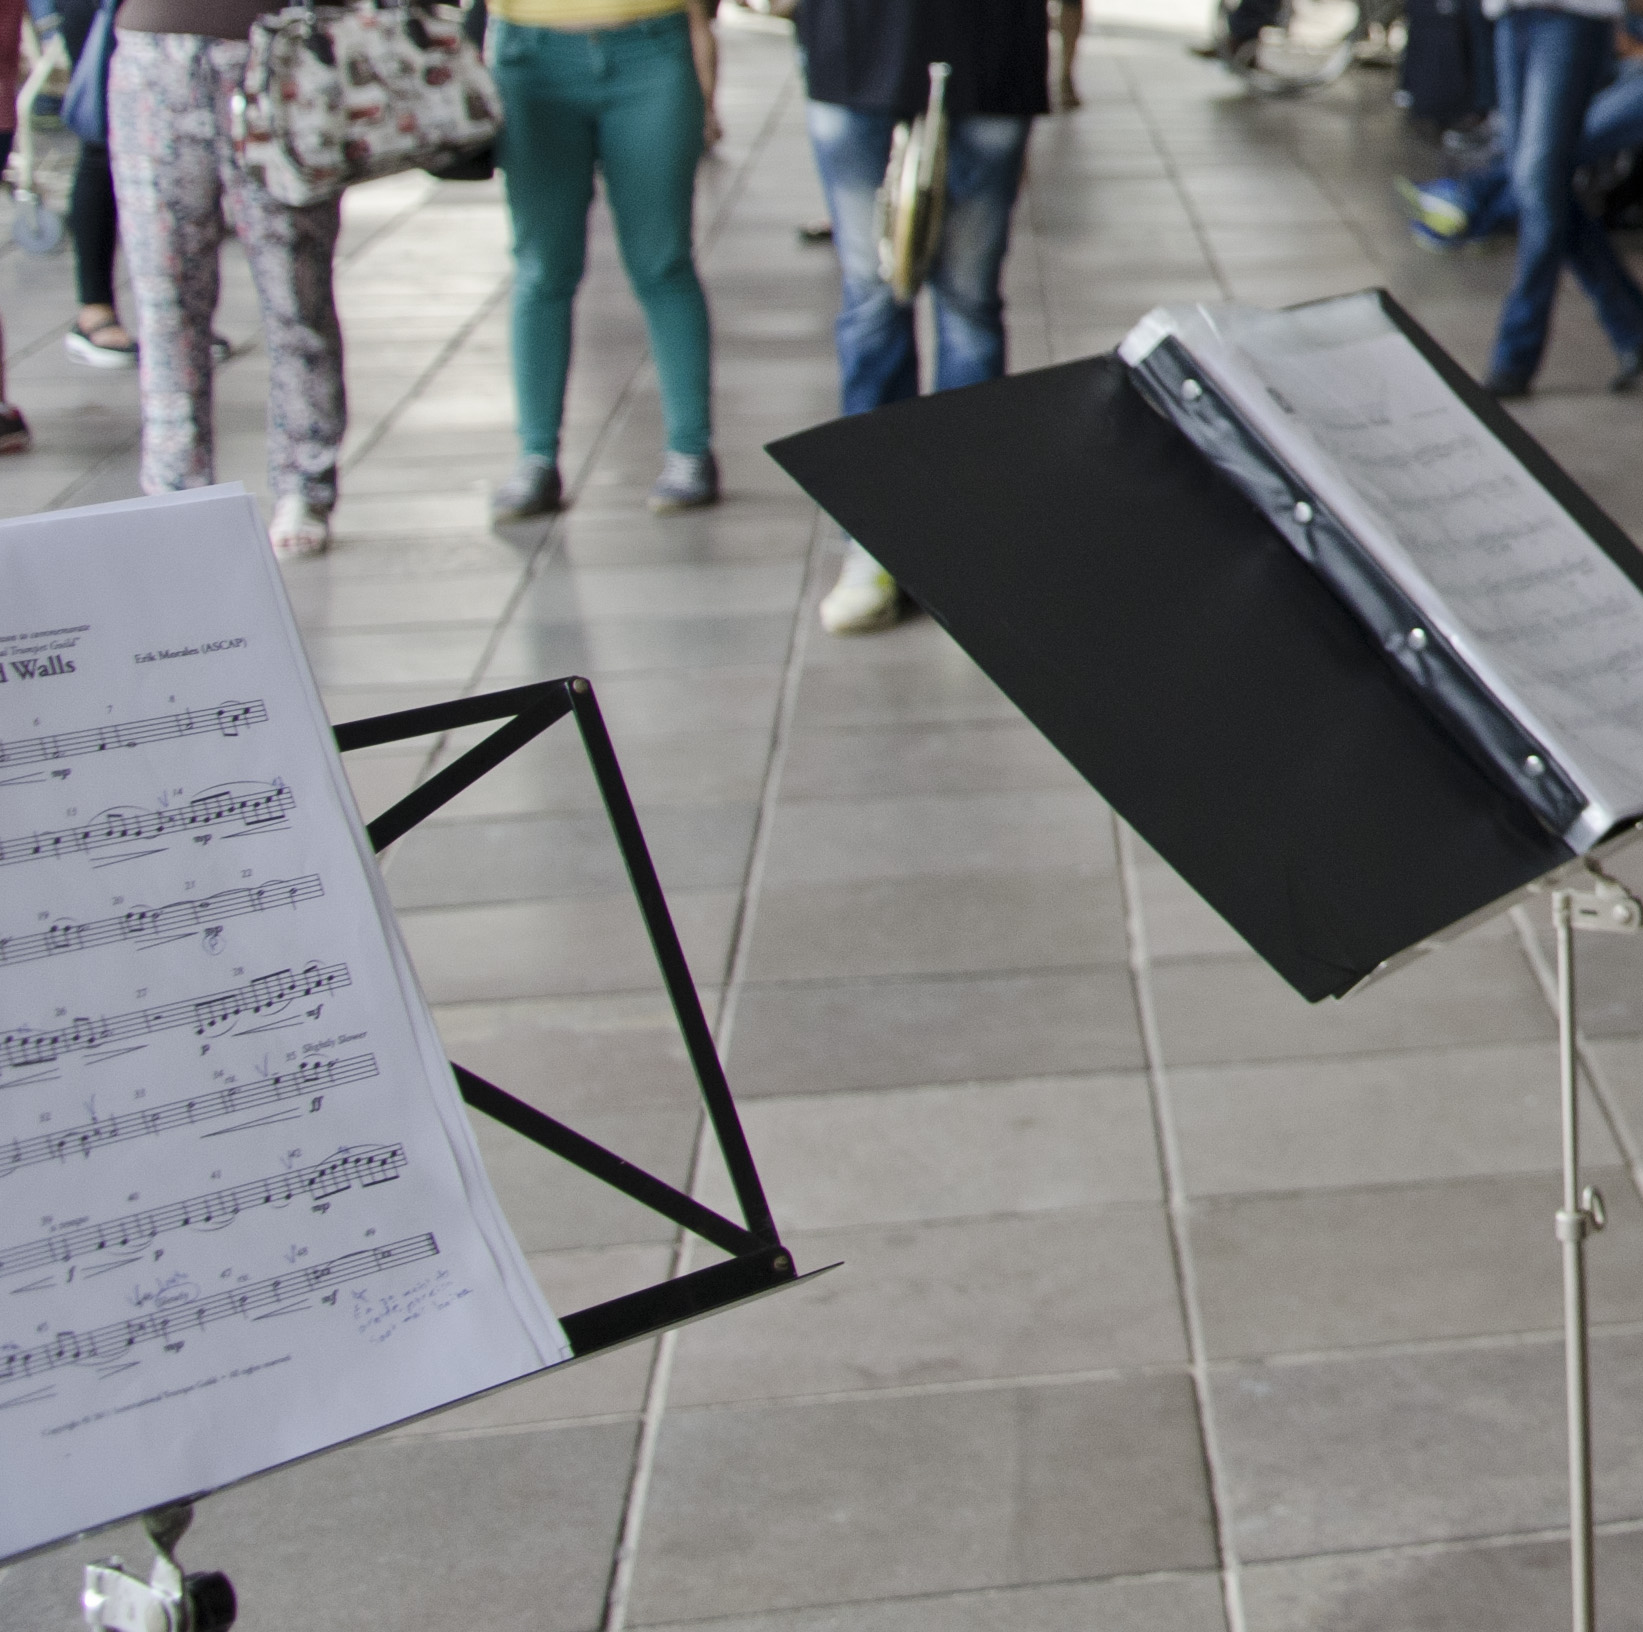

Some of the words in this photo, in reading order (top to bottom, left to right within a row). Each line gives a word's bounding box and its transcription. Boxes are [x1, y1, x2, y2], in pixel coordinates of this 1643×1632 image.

[134, 652, 157, 664] Erik
[158, 647, 200, 660] Morales
[201, 637, 247, 654] (ASCAP)
[9, 654, 77, 680] Walls
[338, 1031, 368, 1045] Slower
